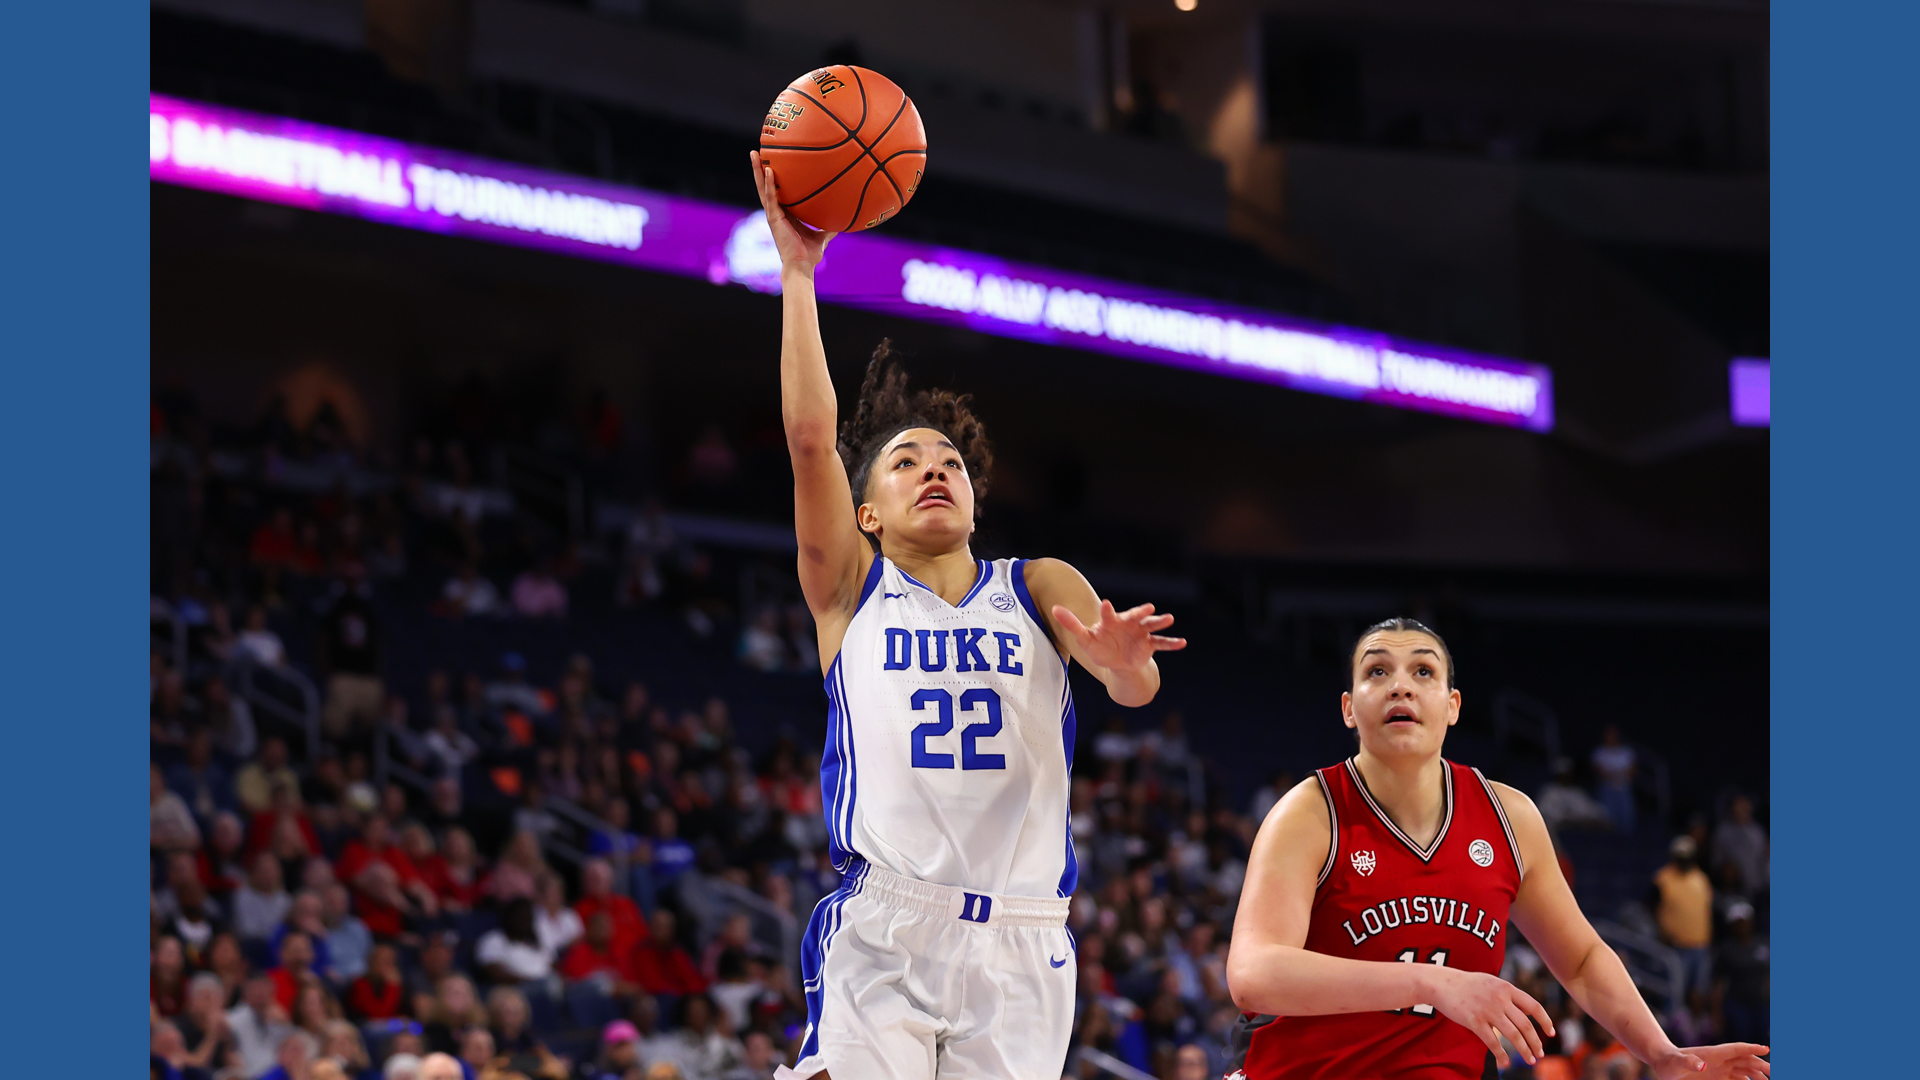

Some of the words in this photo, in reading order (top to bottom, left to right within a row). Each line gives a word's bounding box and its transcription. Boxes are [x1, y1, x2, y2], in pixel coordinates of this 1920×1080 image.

[172, 118, 412, 208] BASKETBALL
[407, 163, 649, 250] TOURNAMENT
[1380, 349, 1541, 417] TOURNAMENT
[884, 628, 1024, 676] DUKE
[911, 688, 1006, 770] 22
[958, 892, 993, 923] D
[1342, 896, 1501, 949] LOUISVILLE
